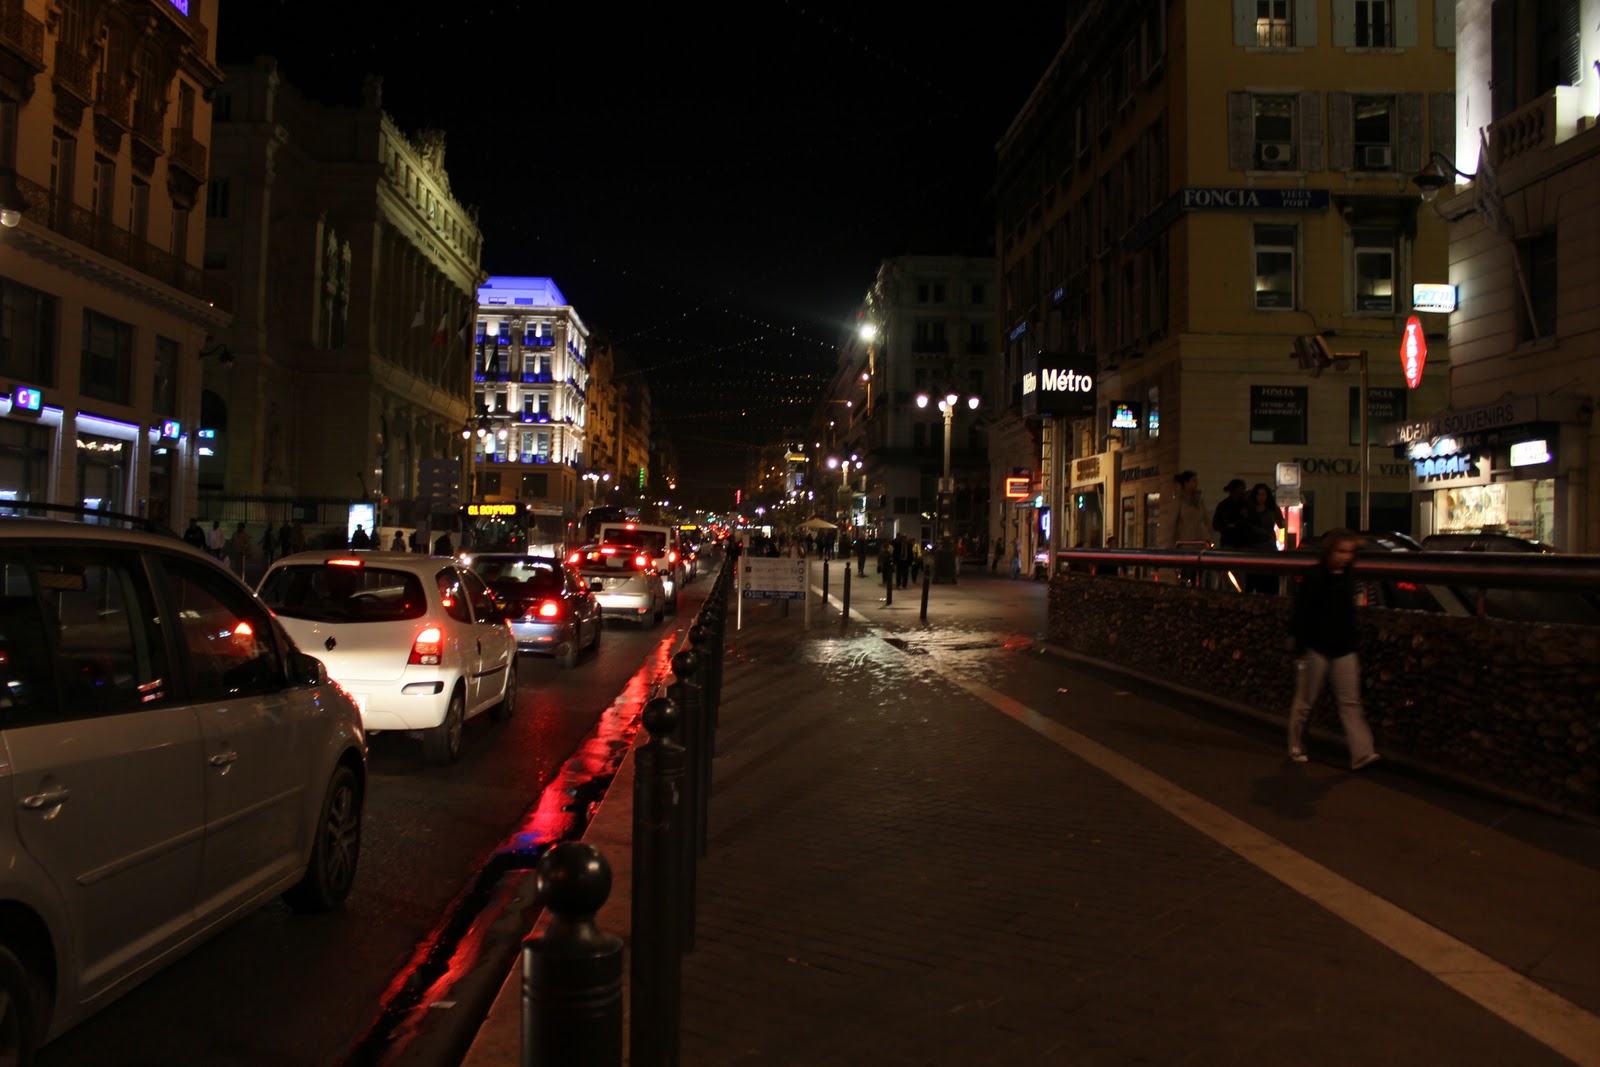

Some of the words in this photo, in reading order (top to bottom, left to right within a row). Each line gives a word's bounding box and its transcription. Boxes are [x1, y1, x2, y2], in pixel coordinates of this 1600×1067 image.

[1183, 189, 1260, 207] FONCIA
[1280, 190, 1312, 199] VIEUX
[1282, 199, 1309, 207] PORT
[1406, 324, 1419, 379] TABAC
[1041, 368, 1093, 393] Métro
[1444, 403, 1515, 434] SOUVENIRS
[1413, 453, 1471, 477] TABAC
